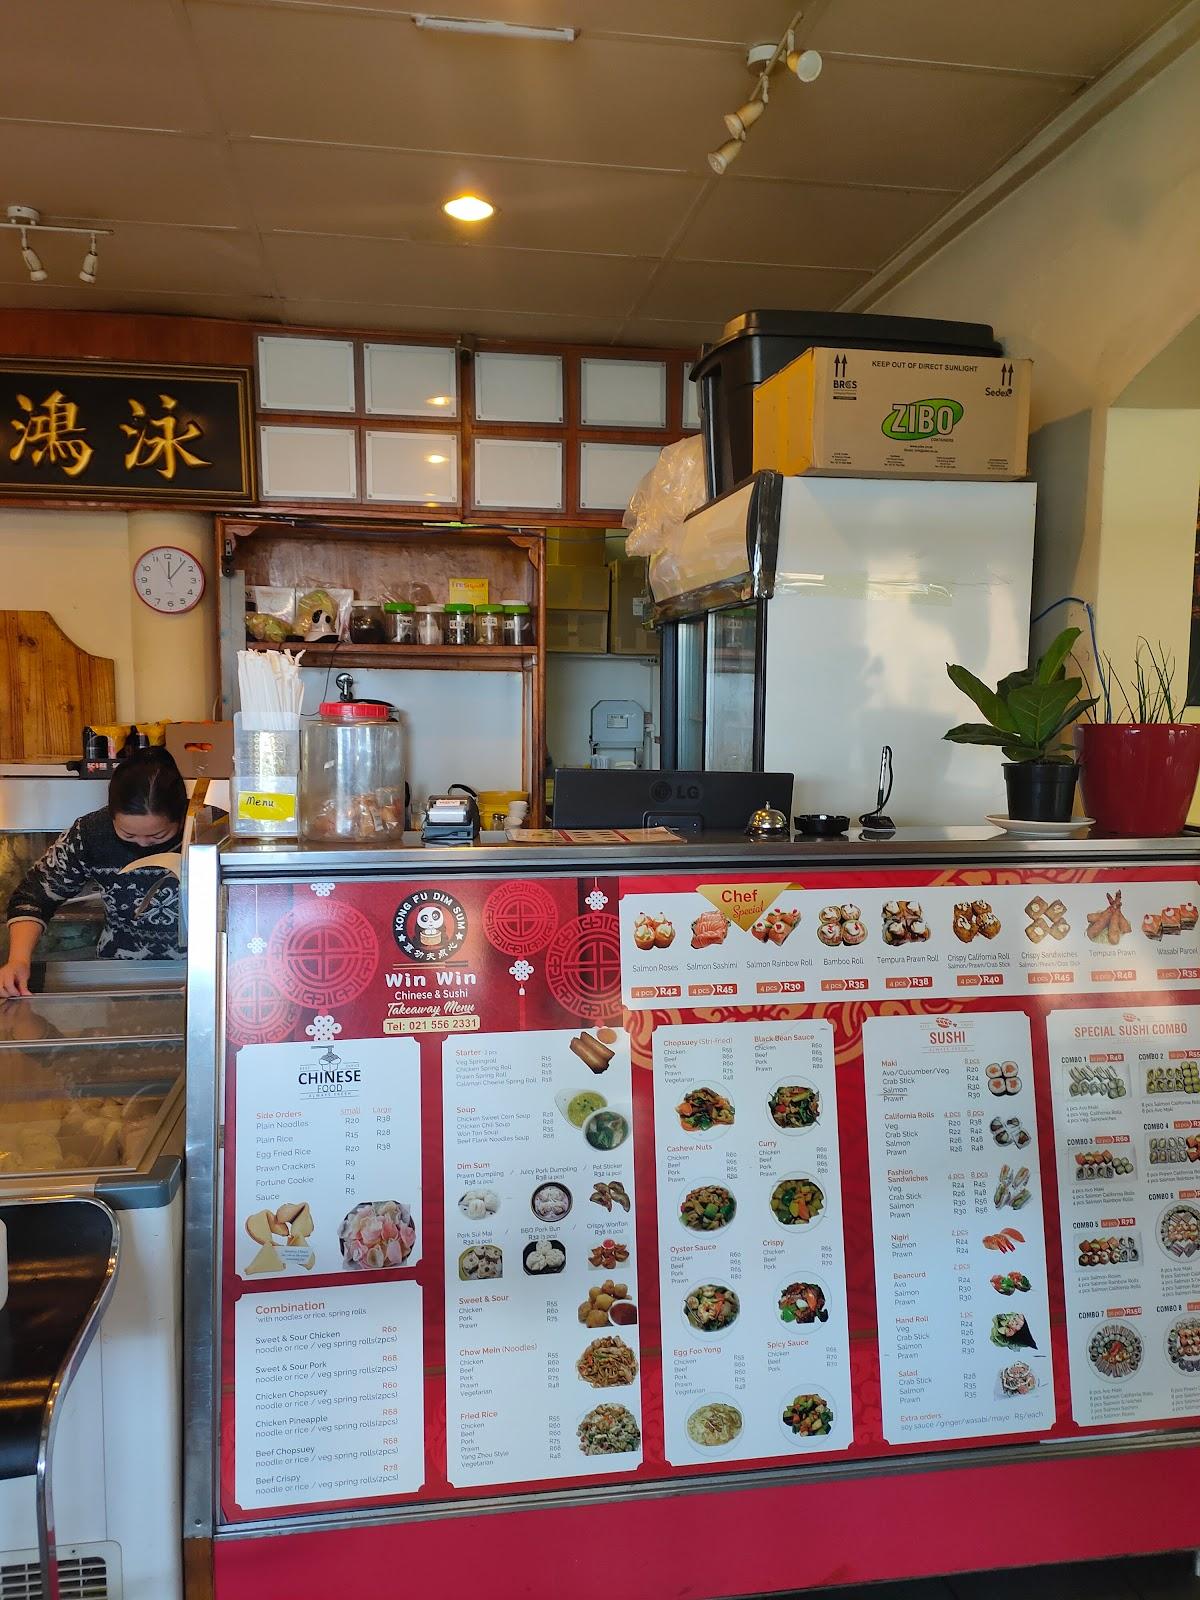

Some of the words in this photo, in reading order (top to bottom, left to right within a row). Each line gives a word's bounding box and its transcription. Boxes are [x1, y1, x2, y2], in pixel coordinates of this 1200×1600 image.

[872, 360, 891, 368] KEEP
[945, 364, 978, 373] SUNLIGHT
[985, 387, 1010, 398] Sedex
[891, 403, 954, 435] ZIBO
[677, 785, 699, 799] LG
[246, 796, 274, 807] Menu
[721, 889, 758, 903] Chef
[396, 903, 412, 930] KONG
[412, 893, 427, 903] FU
[433, 893, 453, 905] DIM
[453, 906, 465, 929] SUM
[733, 900, 765, 920] Special
[948, 954, 966, 962] Crispy
[1021, 952, 1040, 960] Crispy
[1089, 950, 1116, 958] Tempura
[687, 963, 711, 971] Salmon
[746, 960, 771, 968] Salmon
[385, 973, 426, 987] Win
[436, 971, 476, 985] Win
[913, 978, 929, 986] R38
[984, 975, 999, 983] R40
[1055, 974, 1070, 982] R45
[784, 983, 800, 991] R30
[848, 980, 864, 988] R35
[395, 991, 432, 1000] Chinese
[434, 990, 441, 998] &
[443, 989, 468, 998] Sushi
[717, 985, 733, 994] R45
[388, 1002, 441, 1017] Takeaway
[444, 1001, 475, 1015] Menu
[409, 1021, 427, 1030] 021
[432, 1020, 449, 1029] 556
[453, 1019, 476, 1028] 2331
[1075, 1026, 1115, 1038] SPECIAL
[1120, 1025, 1149, 1036] SUSHI
[1153, 1023, 1187, 1034] COMBO
[929, 1031, 966, 1044] SUSHI
[1061, 1056, 1082, 1064] COMBO
[298, 1070, 361, 1085] CHINESE
[317, 1084, 343, 1092] FOOD
[456, 1106, 476, 1114] Soup
[276, 1120, 309, 1128] Noodles
[376, 1115, 391, 1123] R38
[695, 1143, 712, 1151] Nuts
[758, 1140, 777, 1148] Curry
[273, 1149, 293, 1157] Fried
[294, 1148, 311, 1156] Rice
[282, 1162, 316, 1171] Crackers
[457, 1162, 472, 1170] Dim
[256, 1179, 286, 1187] Fortune
[287, 1176, 314, 1184] Cookie
[1073, 1221, 1093, 1229] COMBO
[670, 1245, 693, 1254] Oyster
[695, 1243, 717, 1251] Sauce
[762, 1239, 785, 1248] Crispy
[893, 1272, 926, 1280] Beancurd
[459, 1297, 482, 1305] Sweet
[255, 1301, 325, 1315] Combination
[895, 1316, 914, 1324] Hand
[1079, 1311, 1099, 1319] COMBO
[255, 1337, 280, 1345] Sweet
[290, 1334, 308, 1342] Sour
[309, 1331, 341, 1340] Chicken
[767, 1341, 786, 1350] Spicy
[787, 1339, 809, 1347] Sauce
[459, 1349, 481, 1357] Chow
[482, 1347, 500, 1355] Mein
[502, 1343, 538, 1353] (Noodles)
[673, 1349, 687, 1358] Egg
[703, 1347, 722, 1355] Yong
[898, 1370, 918, 1378] Salad
[255, 1392, 287, 1401] Chicken
[288, 1389, 328, 1398] Chopsuey
[460, 1412, 480, 1420] Fried
[255, 1419, 287, 1428] Chicken
[289, 1415, 328, 1425] Pineapple
[255, 1450, 275, 1458] Beef
[276, 1446, 315, 1457] Chopsuey
[255, 1477, 275, 1485] Beef
[276, 1474, 301, 1483] Crispy
